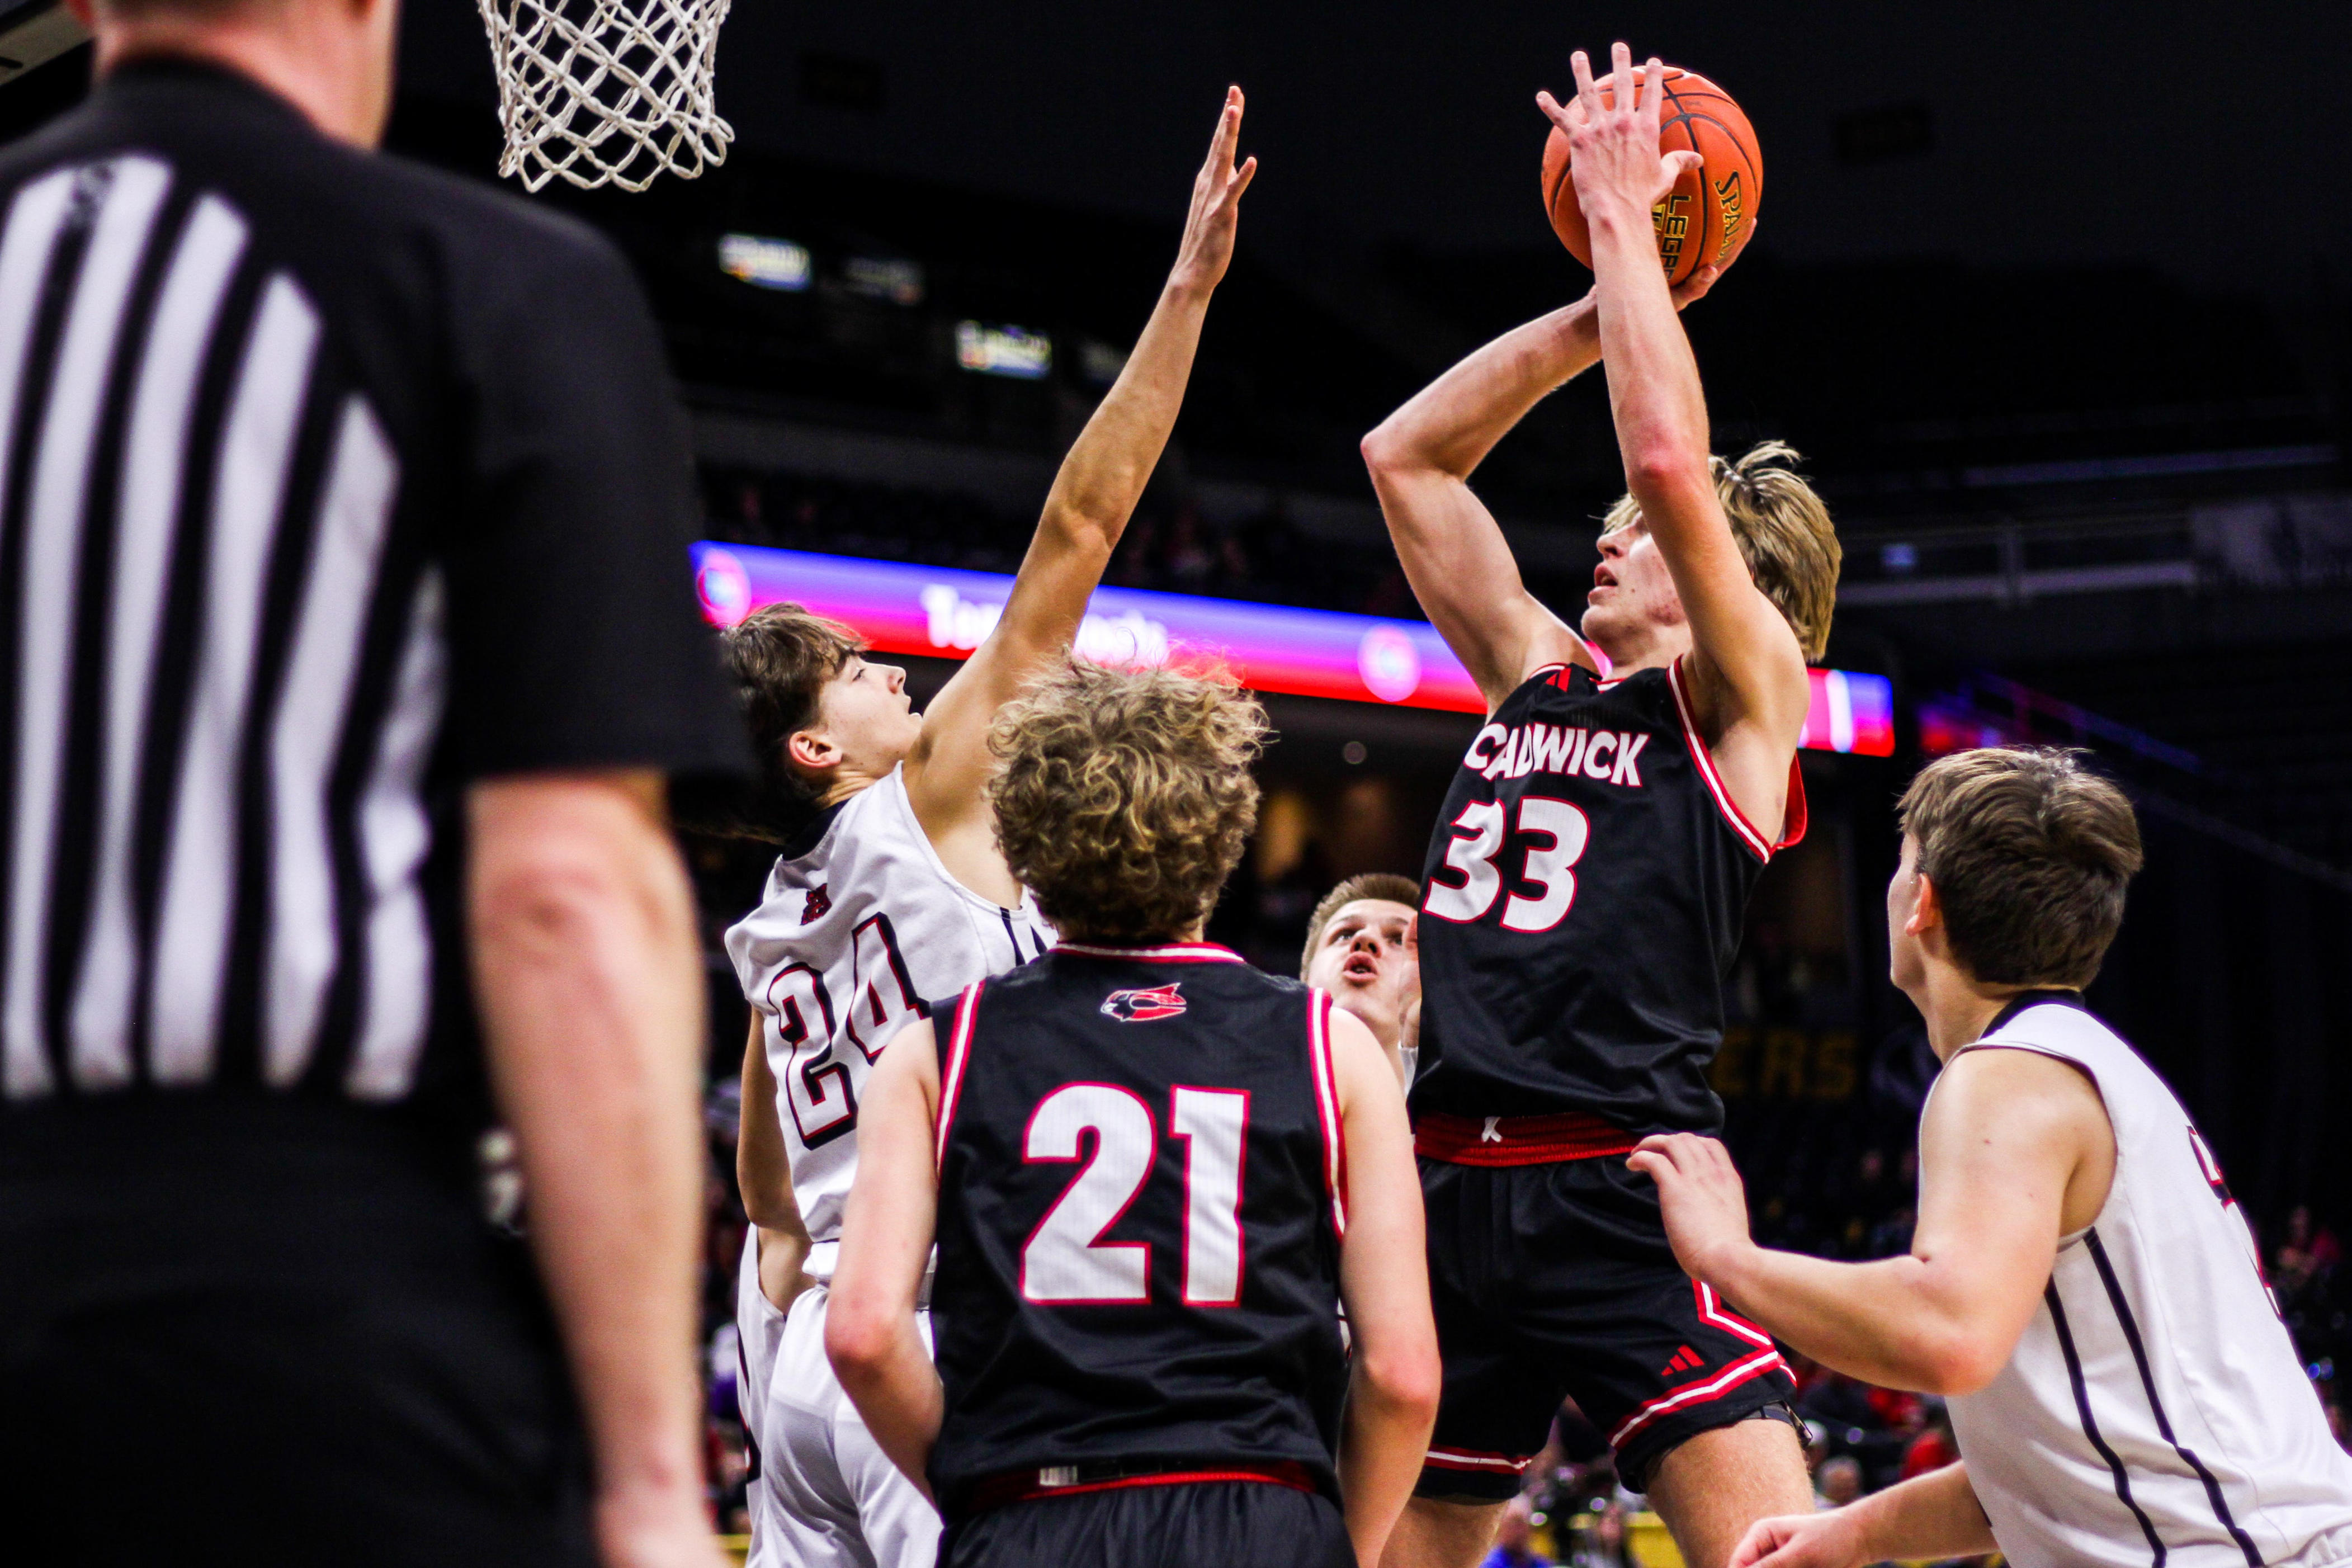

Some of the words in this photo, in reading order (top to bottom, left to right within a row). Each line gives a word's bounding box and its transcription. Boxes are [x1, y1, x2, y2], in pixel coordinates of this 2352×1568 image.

[1421, 795, 1591, 933] 33
[767, 911, 932, 1151] 24
[1021, 1080, 1251, 1307] 21
